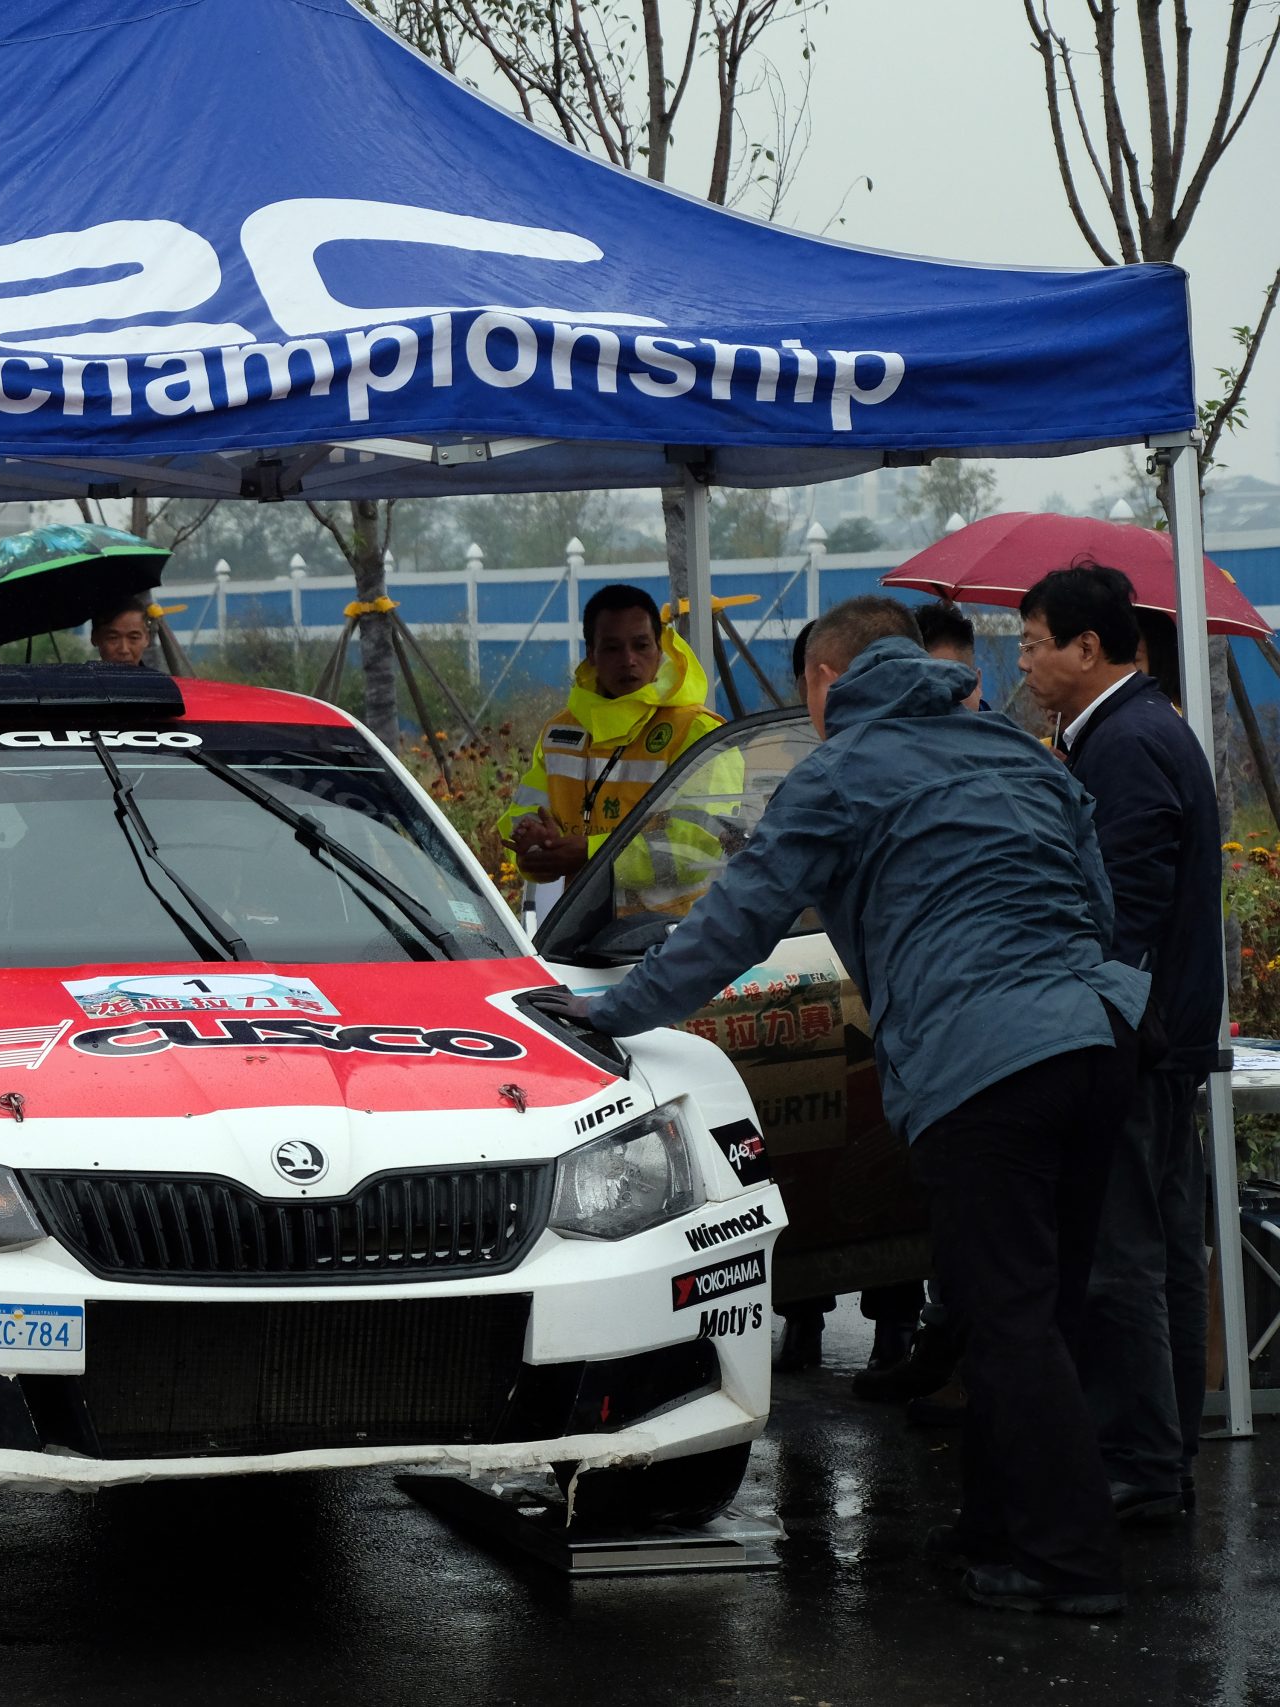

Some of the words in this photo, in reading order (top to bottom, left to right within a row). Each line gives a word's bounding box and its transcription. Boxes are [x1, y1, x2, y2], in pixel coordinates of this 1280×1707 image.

[92, 994, 326, 1016] 龙游拉力赛
[182, 978, 213, 994] 1
[68, 1018, 528, 1061] CUSCO
[670, 1004, 833, 1050] 游拉力赛
[757, 1090, 842, 1127] ÜRTH
[695, 1258, 761, 1296] YOKOHAMA
[696, 1301, 763, 1340] Moty's
